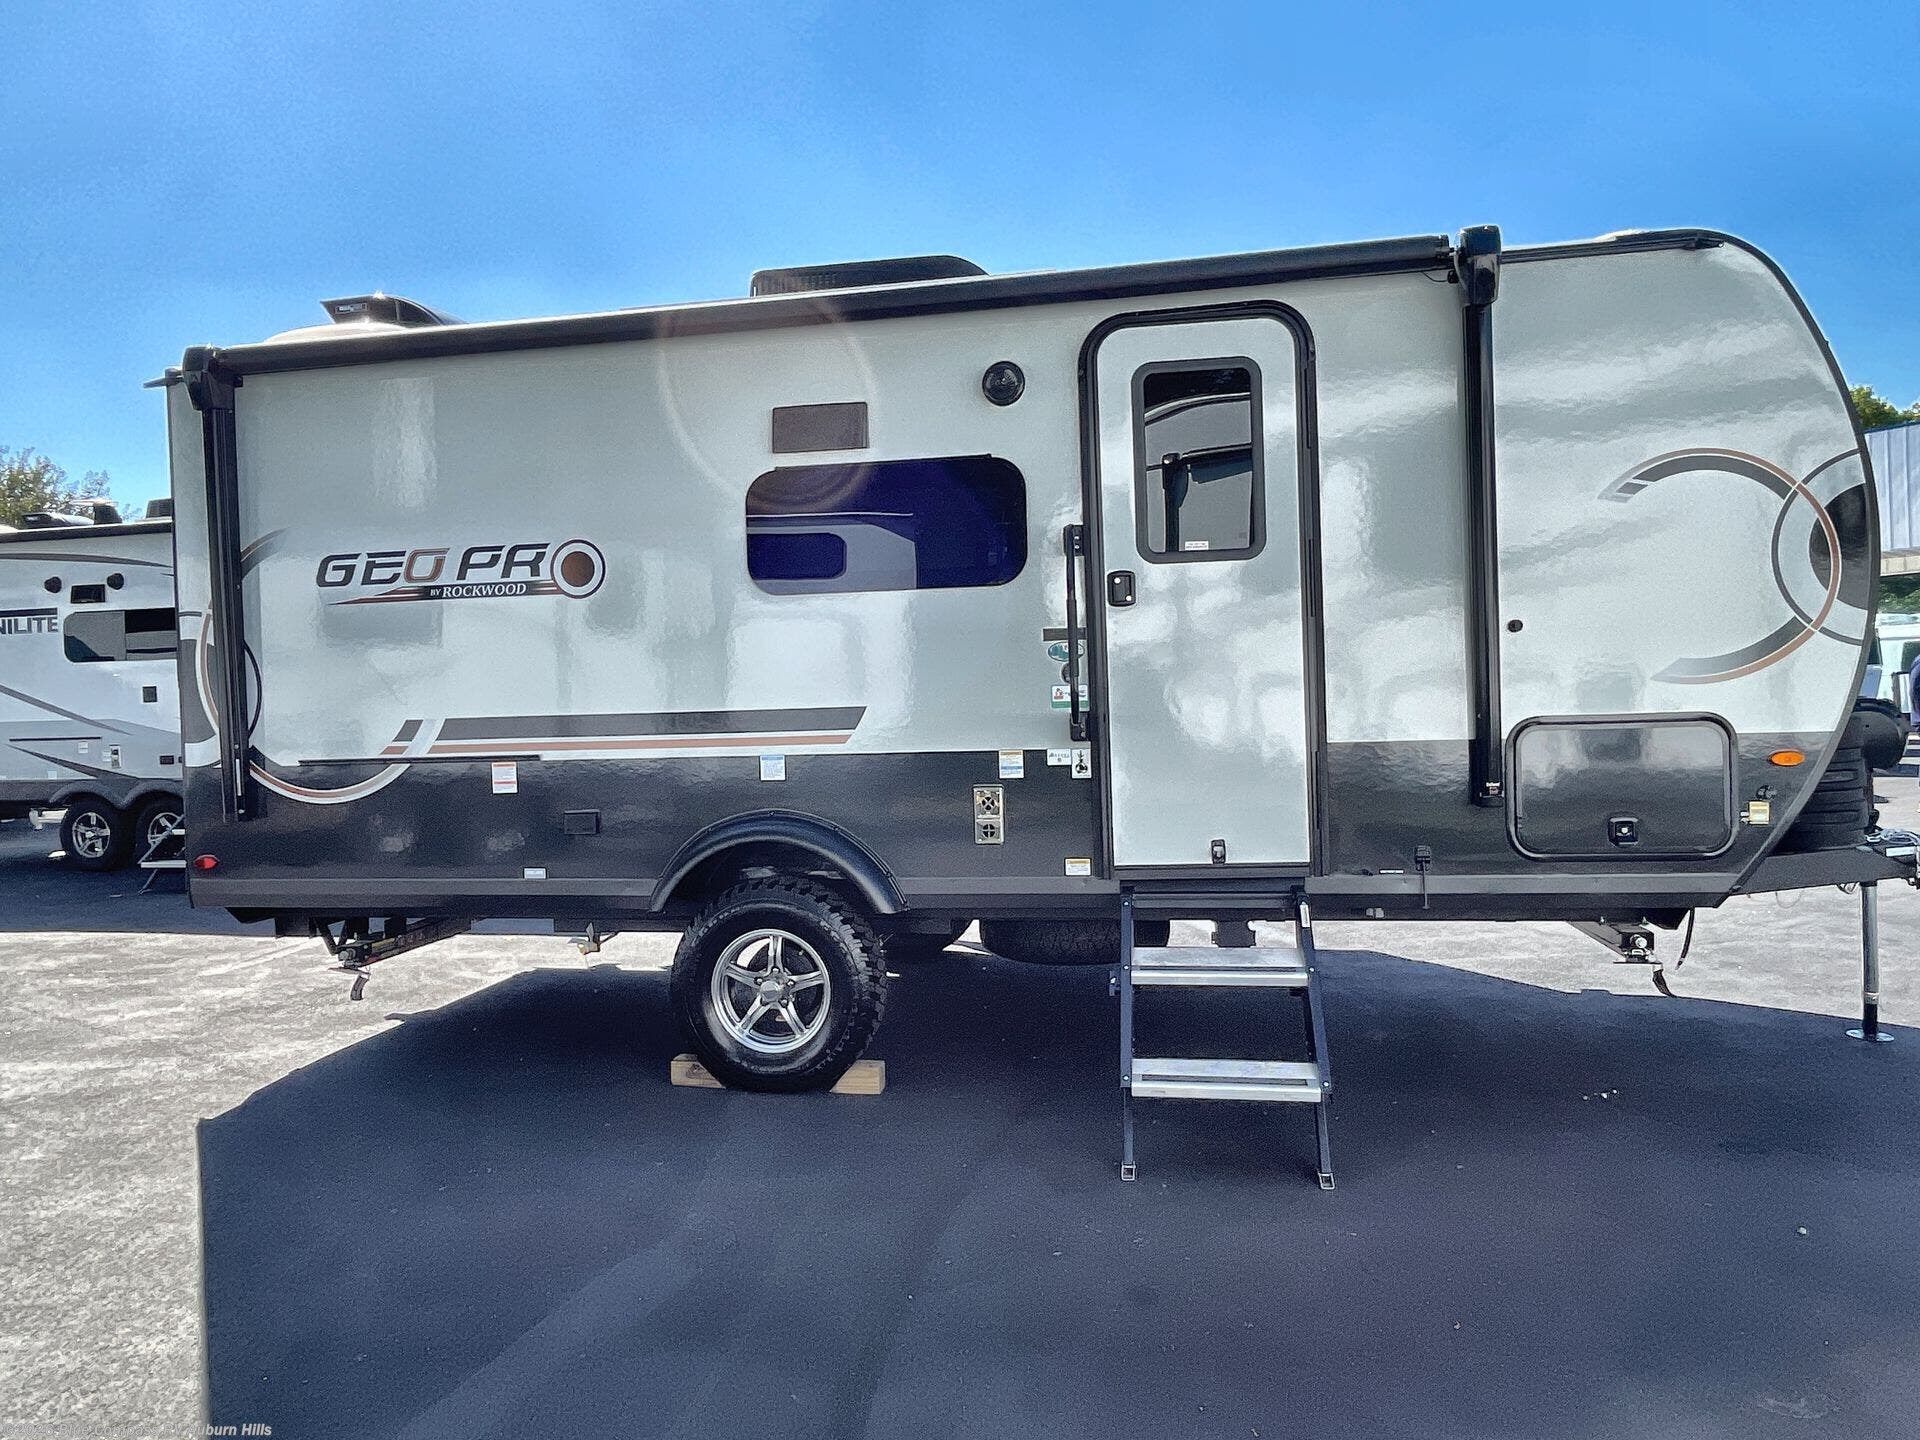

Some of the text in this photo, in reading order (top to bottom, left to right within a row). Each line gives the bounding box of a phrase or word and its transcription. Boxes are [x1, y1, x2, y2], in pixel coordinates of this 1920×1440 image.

[316, 547, 450, 588] GEO
[430, 583, 527, 598] BY ROCKWOOD
